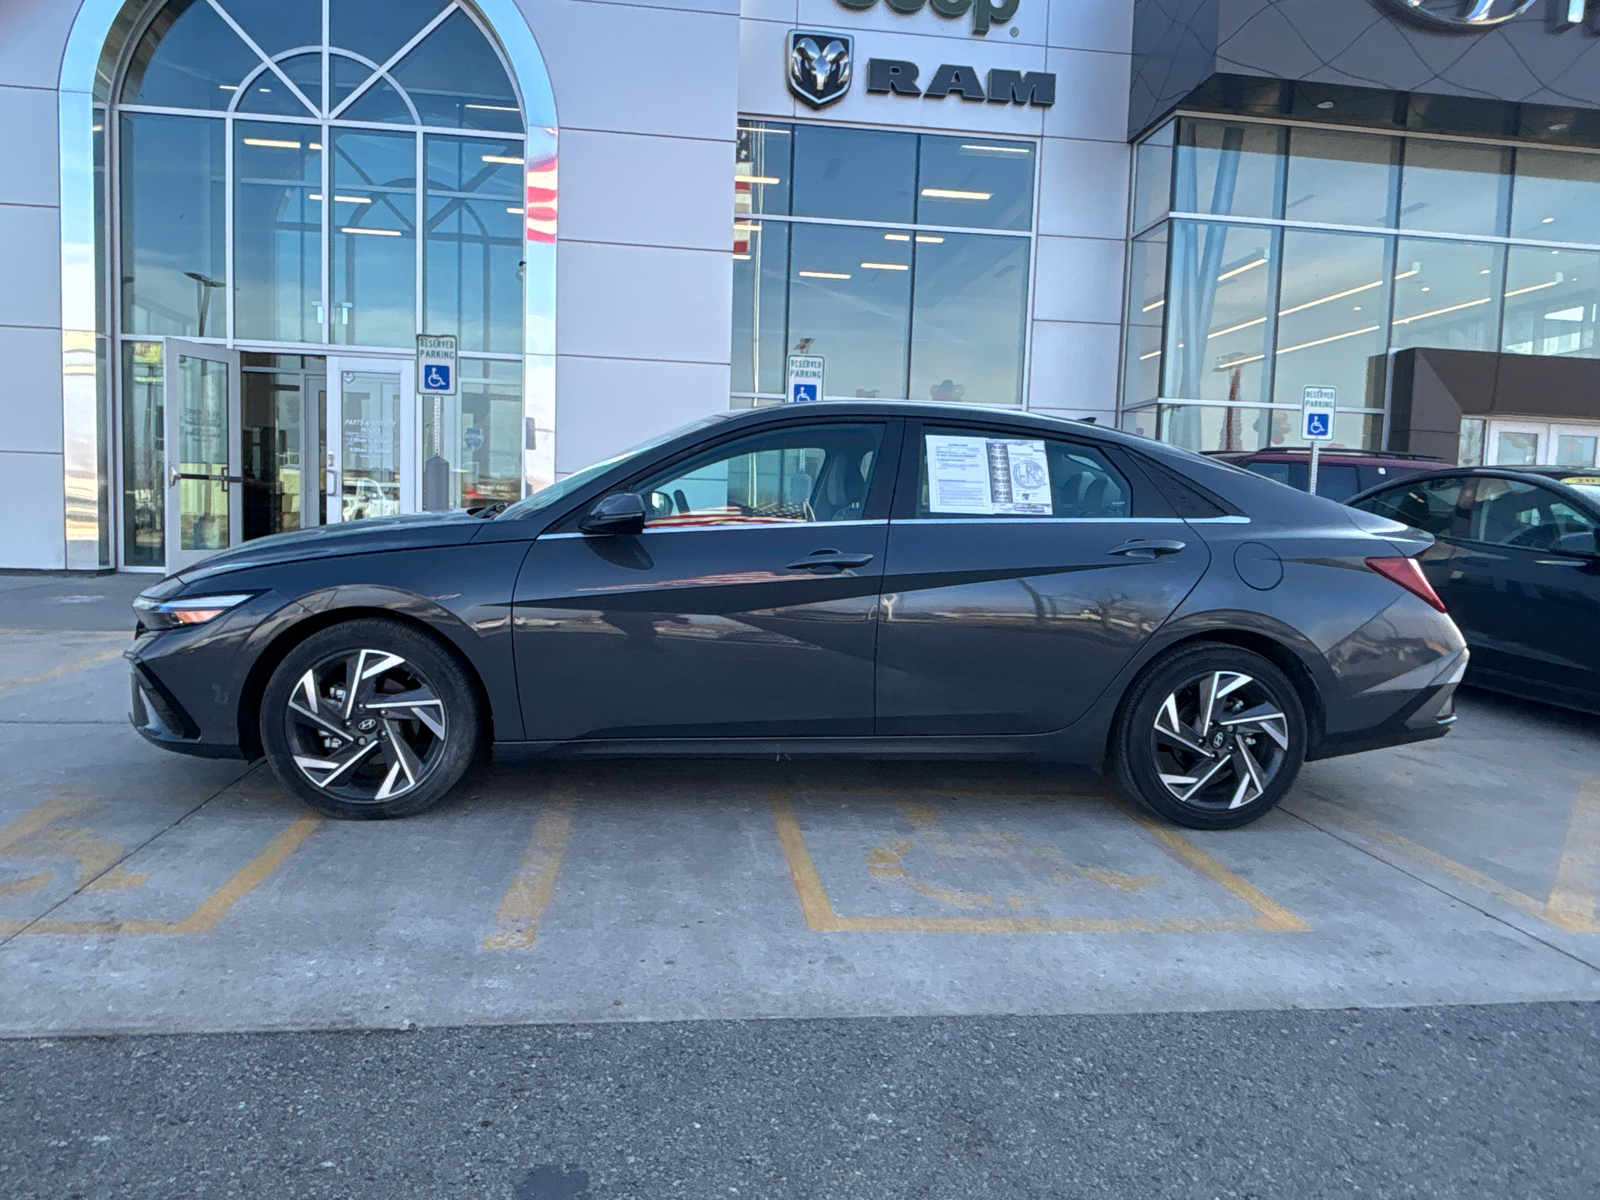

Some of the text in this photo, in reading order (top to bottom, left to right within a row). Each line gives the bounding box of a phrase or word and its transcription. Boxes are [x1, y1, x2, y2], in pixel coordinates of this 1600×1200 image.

[867, 57, 1057, 107] RAM
[419, 338, 454, 349] RESERVED
[419, 350, 454, 360] PARKING
[790, 359, 822, 369] RESERVED
[790, 370, 822, 379] PARKING
[1305, 390, 1334, 399] RESERVED
[1305, 400, 1334, 408] PARKING
